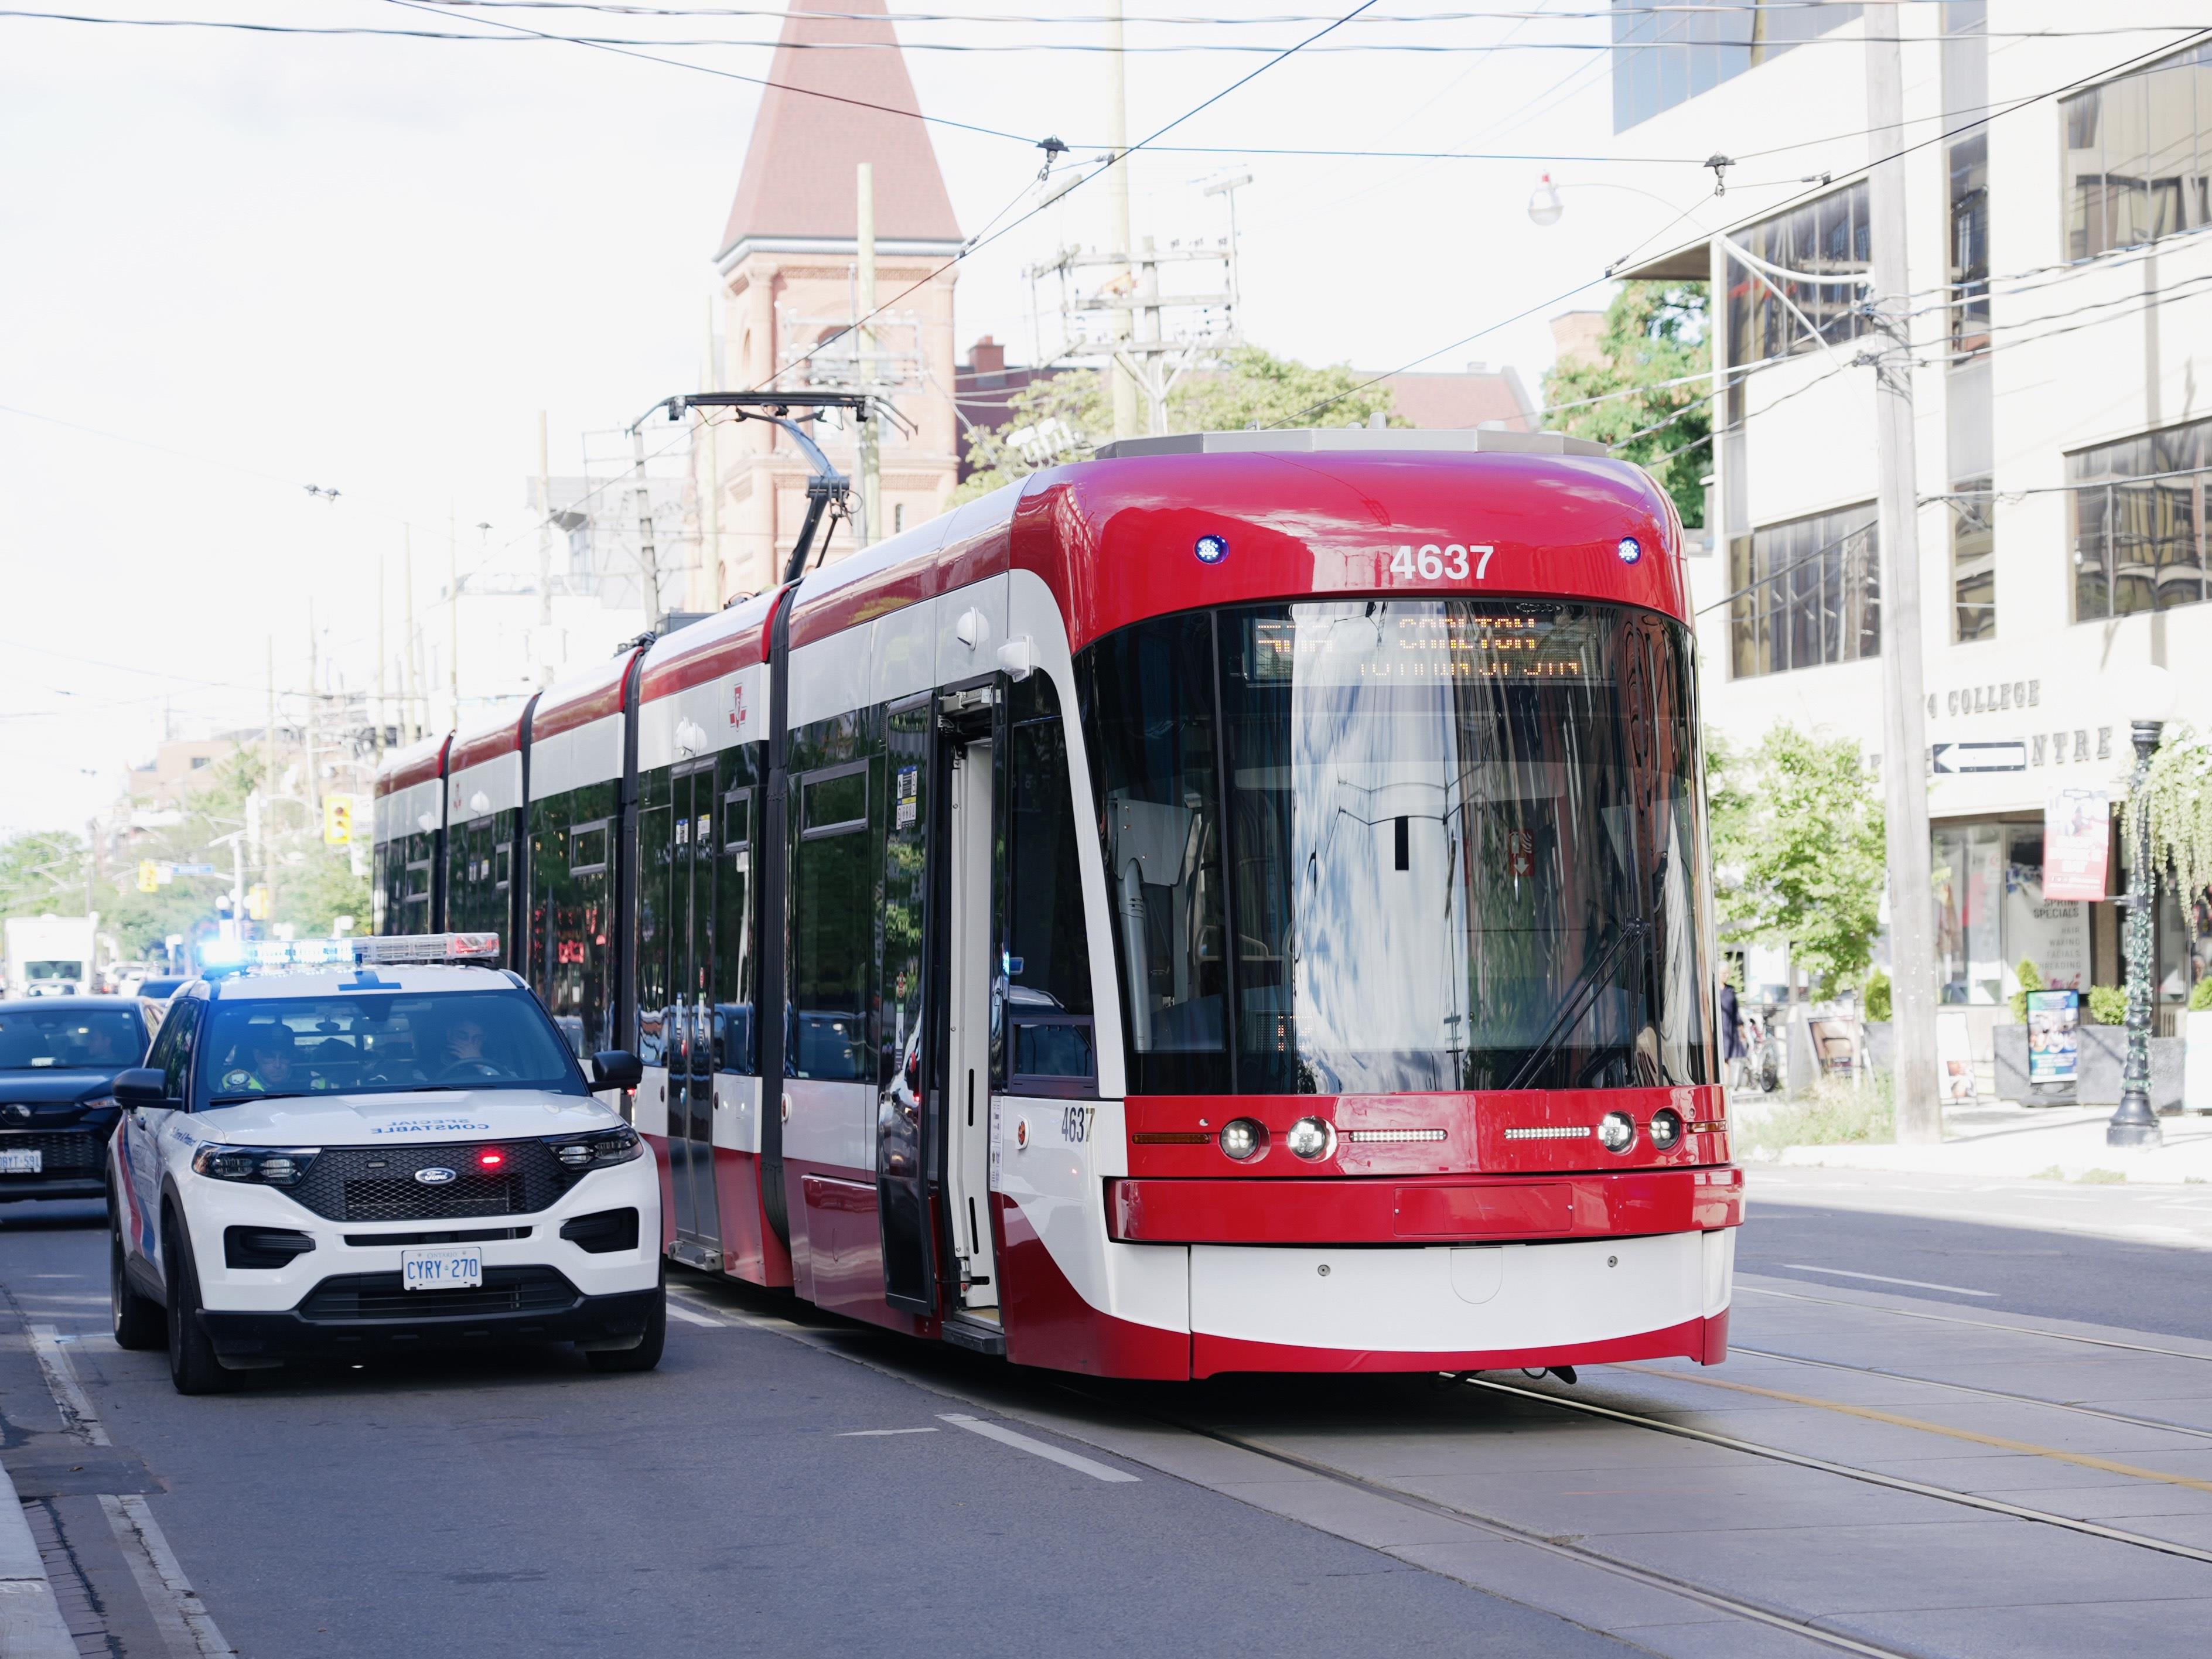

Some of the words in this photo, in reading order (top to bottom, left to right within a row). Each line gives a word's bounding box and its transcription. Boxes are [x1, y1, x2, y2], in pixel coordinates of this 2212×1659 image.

[1389, 544, 1494, 580] 4637
[1948, 679, 2040, 716] COLLEGE
[2033, 908, 2079, 919] SPECIALS
[1061, 1107, 1095, 1142] 4637
[407, 1260, 441, 1279] CYRY
[452, 1258, 477, 1278] 270
